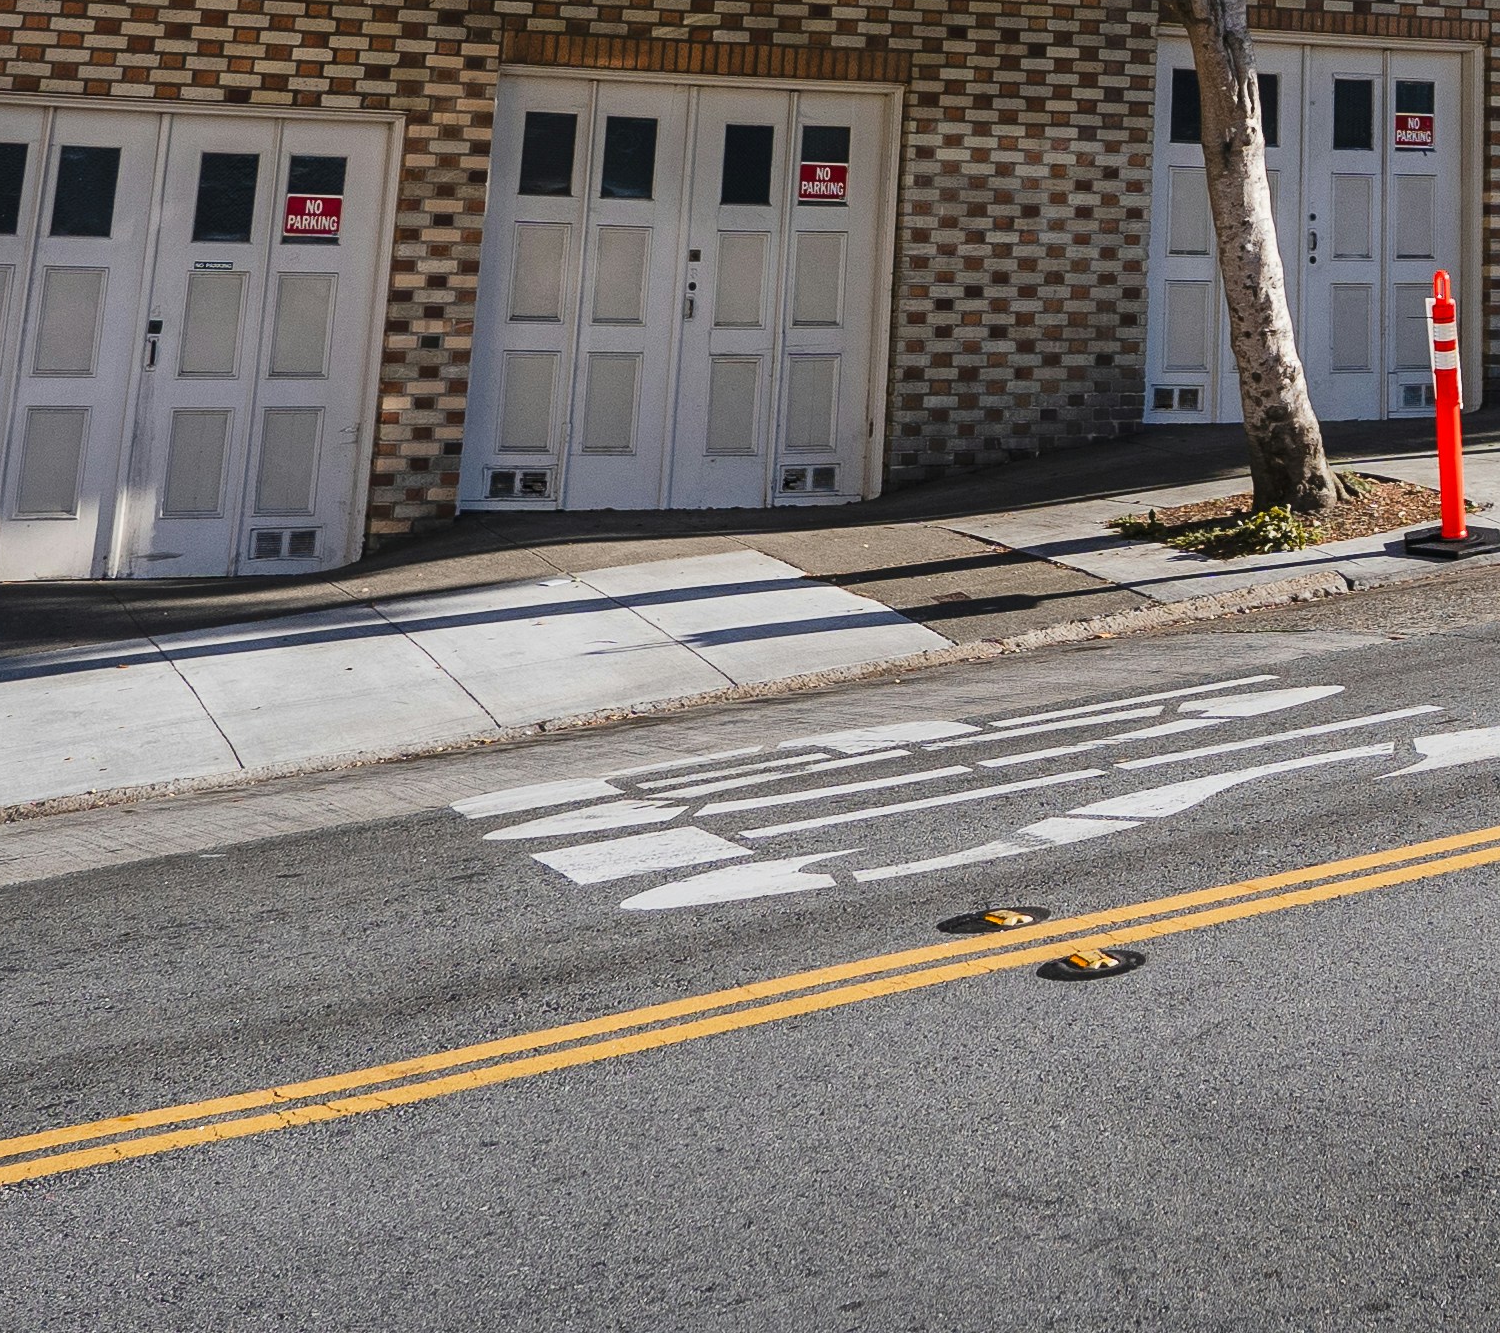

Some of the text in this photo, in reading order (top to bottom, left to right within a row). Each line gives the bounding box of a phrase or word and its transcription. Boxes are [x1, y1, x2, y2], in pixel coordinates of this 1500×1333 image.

[1408, 117, 1420, 130] NO
[1396, 130, 1431, 142] PARKING
[816, 167, 831, 181] NO
[801, 181, 844, 195] PARKING
[305, 199, 323, 214] NO
[287, 215, 338, 231] PARKING
